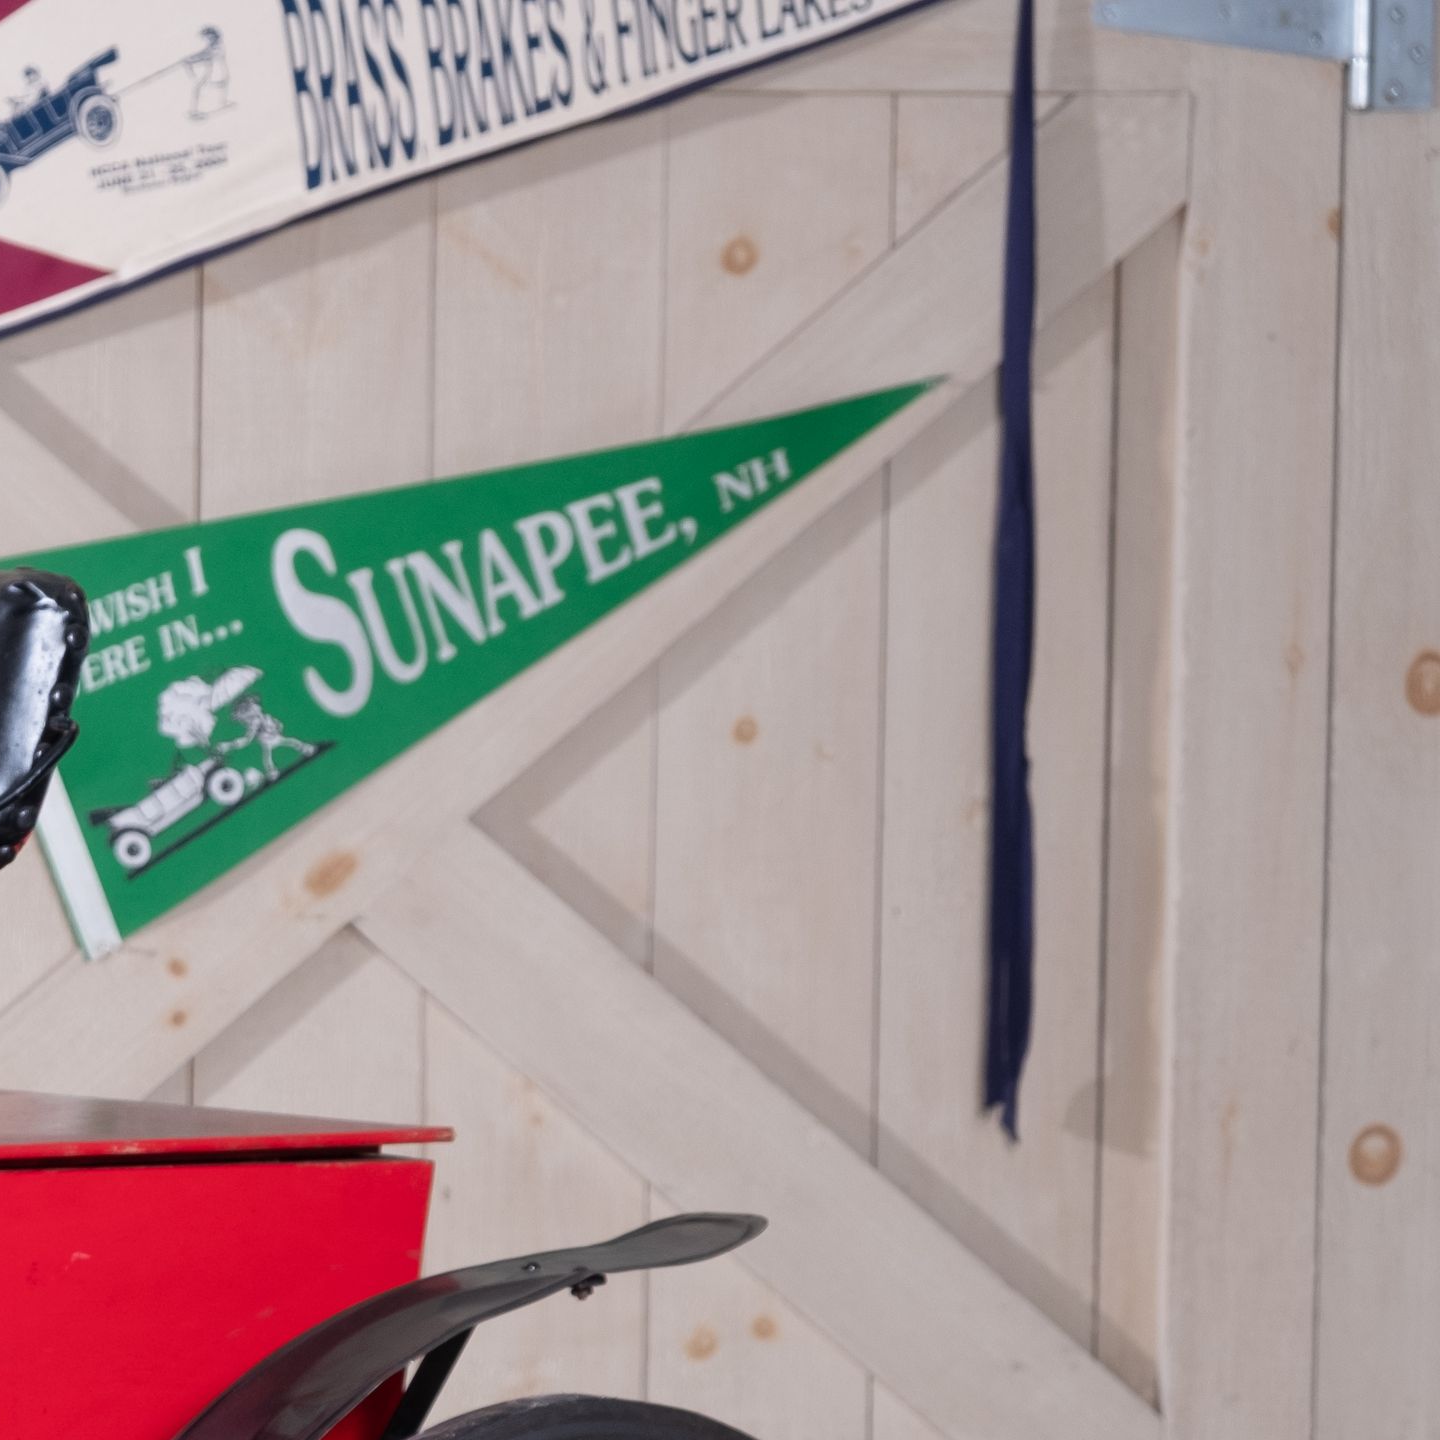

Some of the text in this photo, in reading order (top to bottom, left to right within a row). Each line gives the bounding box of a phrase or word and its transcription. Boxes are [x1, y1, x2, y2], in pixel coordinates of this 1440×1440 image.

[280, 0, 873, 190] BRASS BRAKES & FINGER LAK
[711, 446, 791, 514] NH
[88, 545, 209, 638] WISH I
[76, 614, 244, 698] ERE IN...
